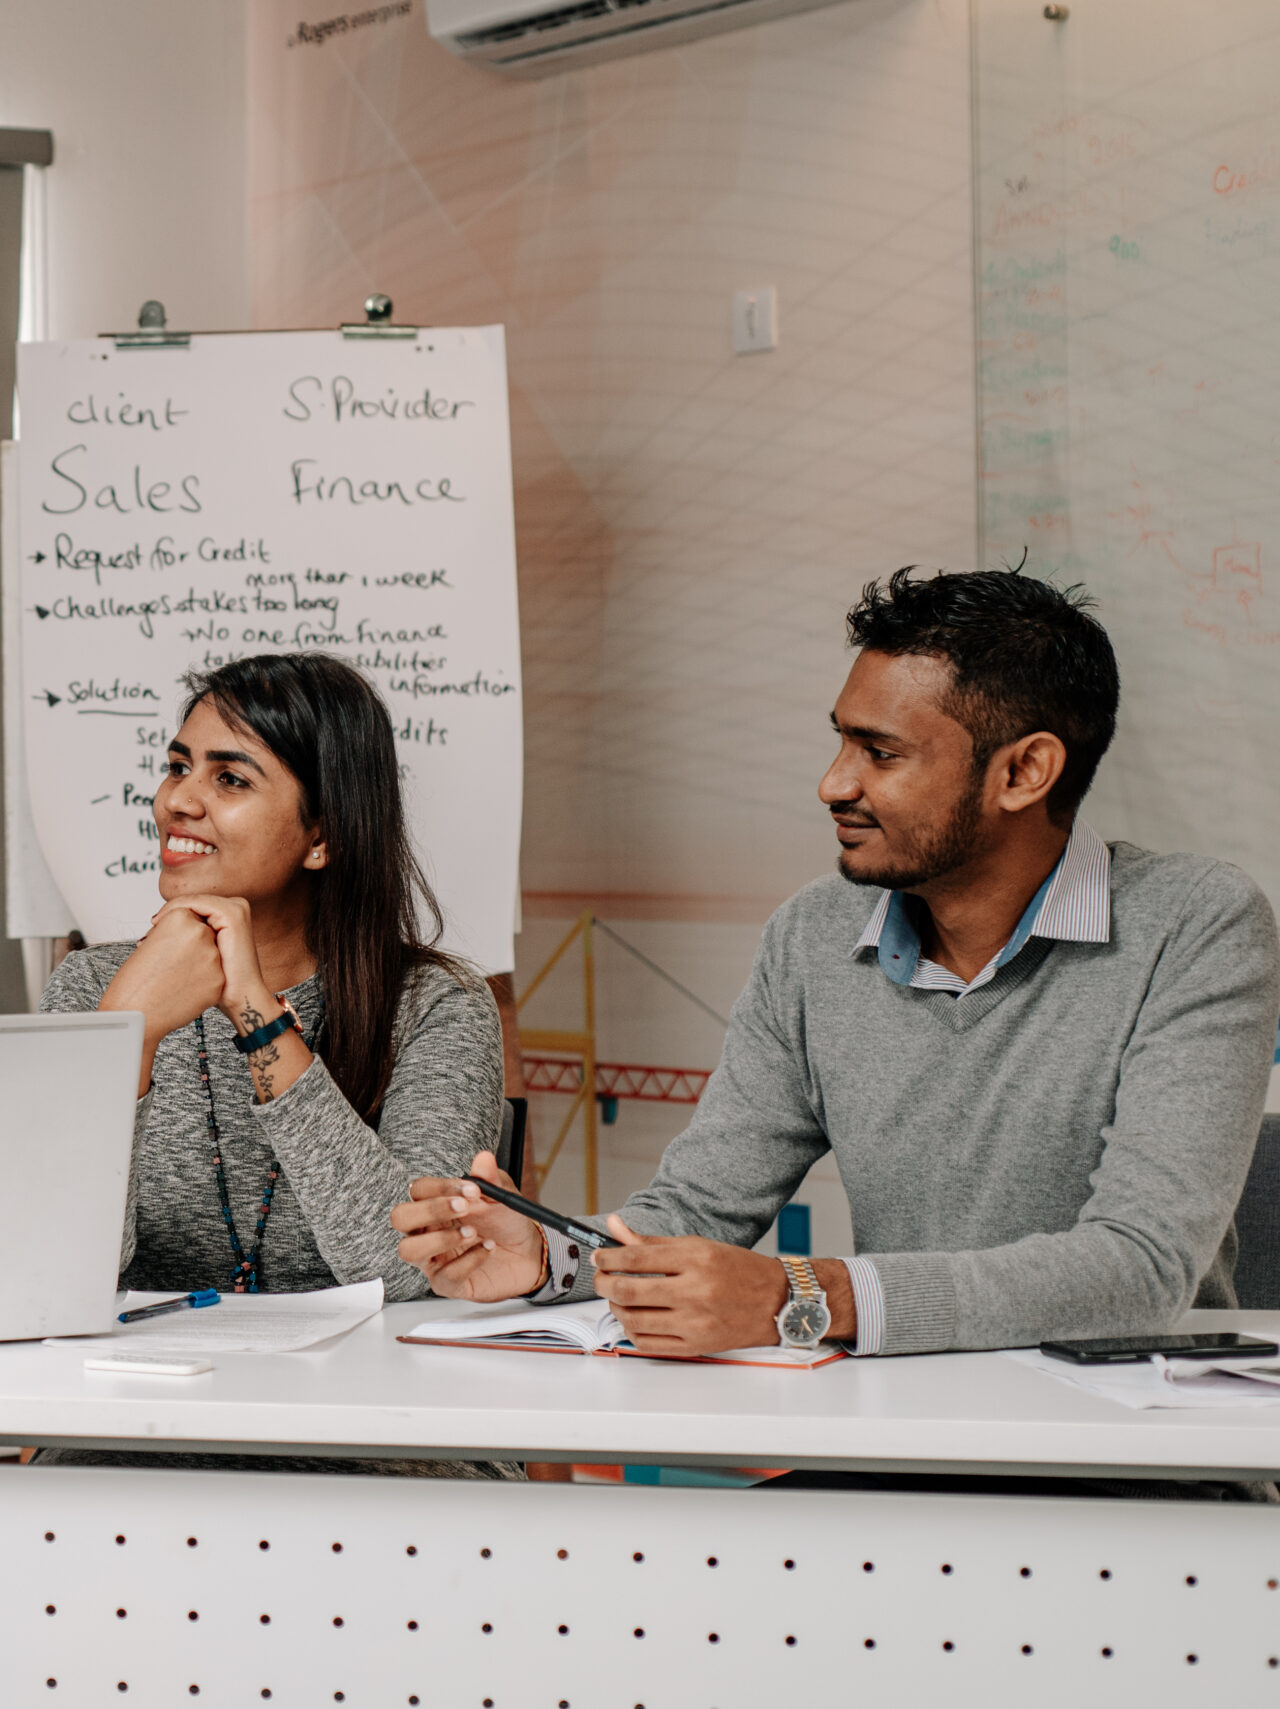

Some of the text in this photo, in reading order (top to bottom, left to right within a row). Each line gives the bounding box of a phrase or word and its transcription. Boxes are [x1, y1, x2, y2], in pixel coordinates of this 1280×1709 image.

[41, 444, 203, 514] Sales
[290, 459, 467, 506] Finance
[54, 533, 271, 586] Request for Credit
[51, 596, 171, 640] Challenges
[194, 618, 230, 644] No
[242, 627, 290, 646] one
[291, 621, 354, 650] from
[66, 678, 162, 703] Solution
